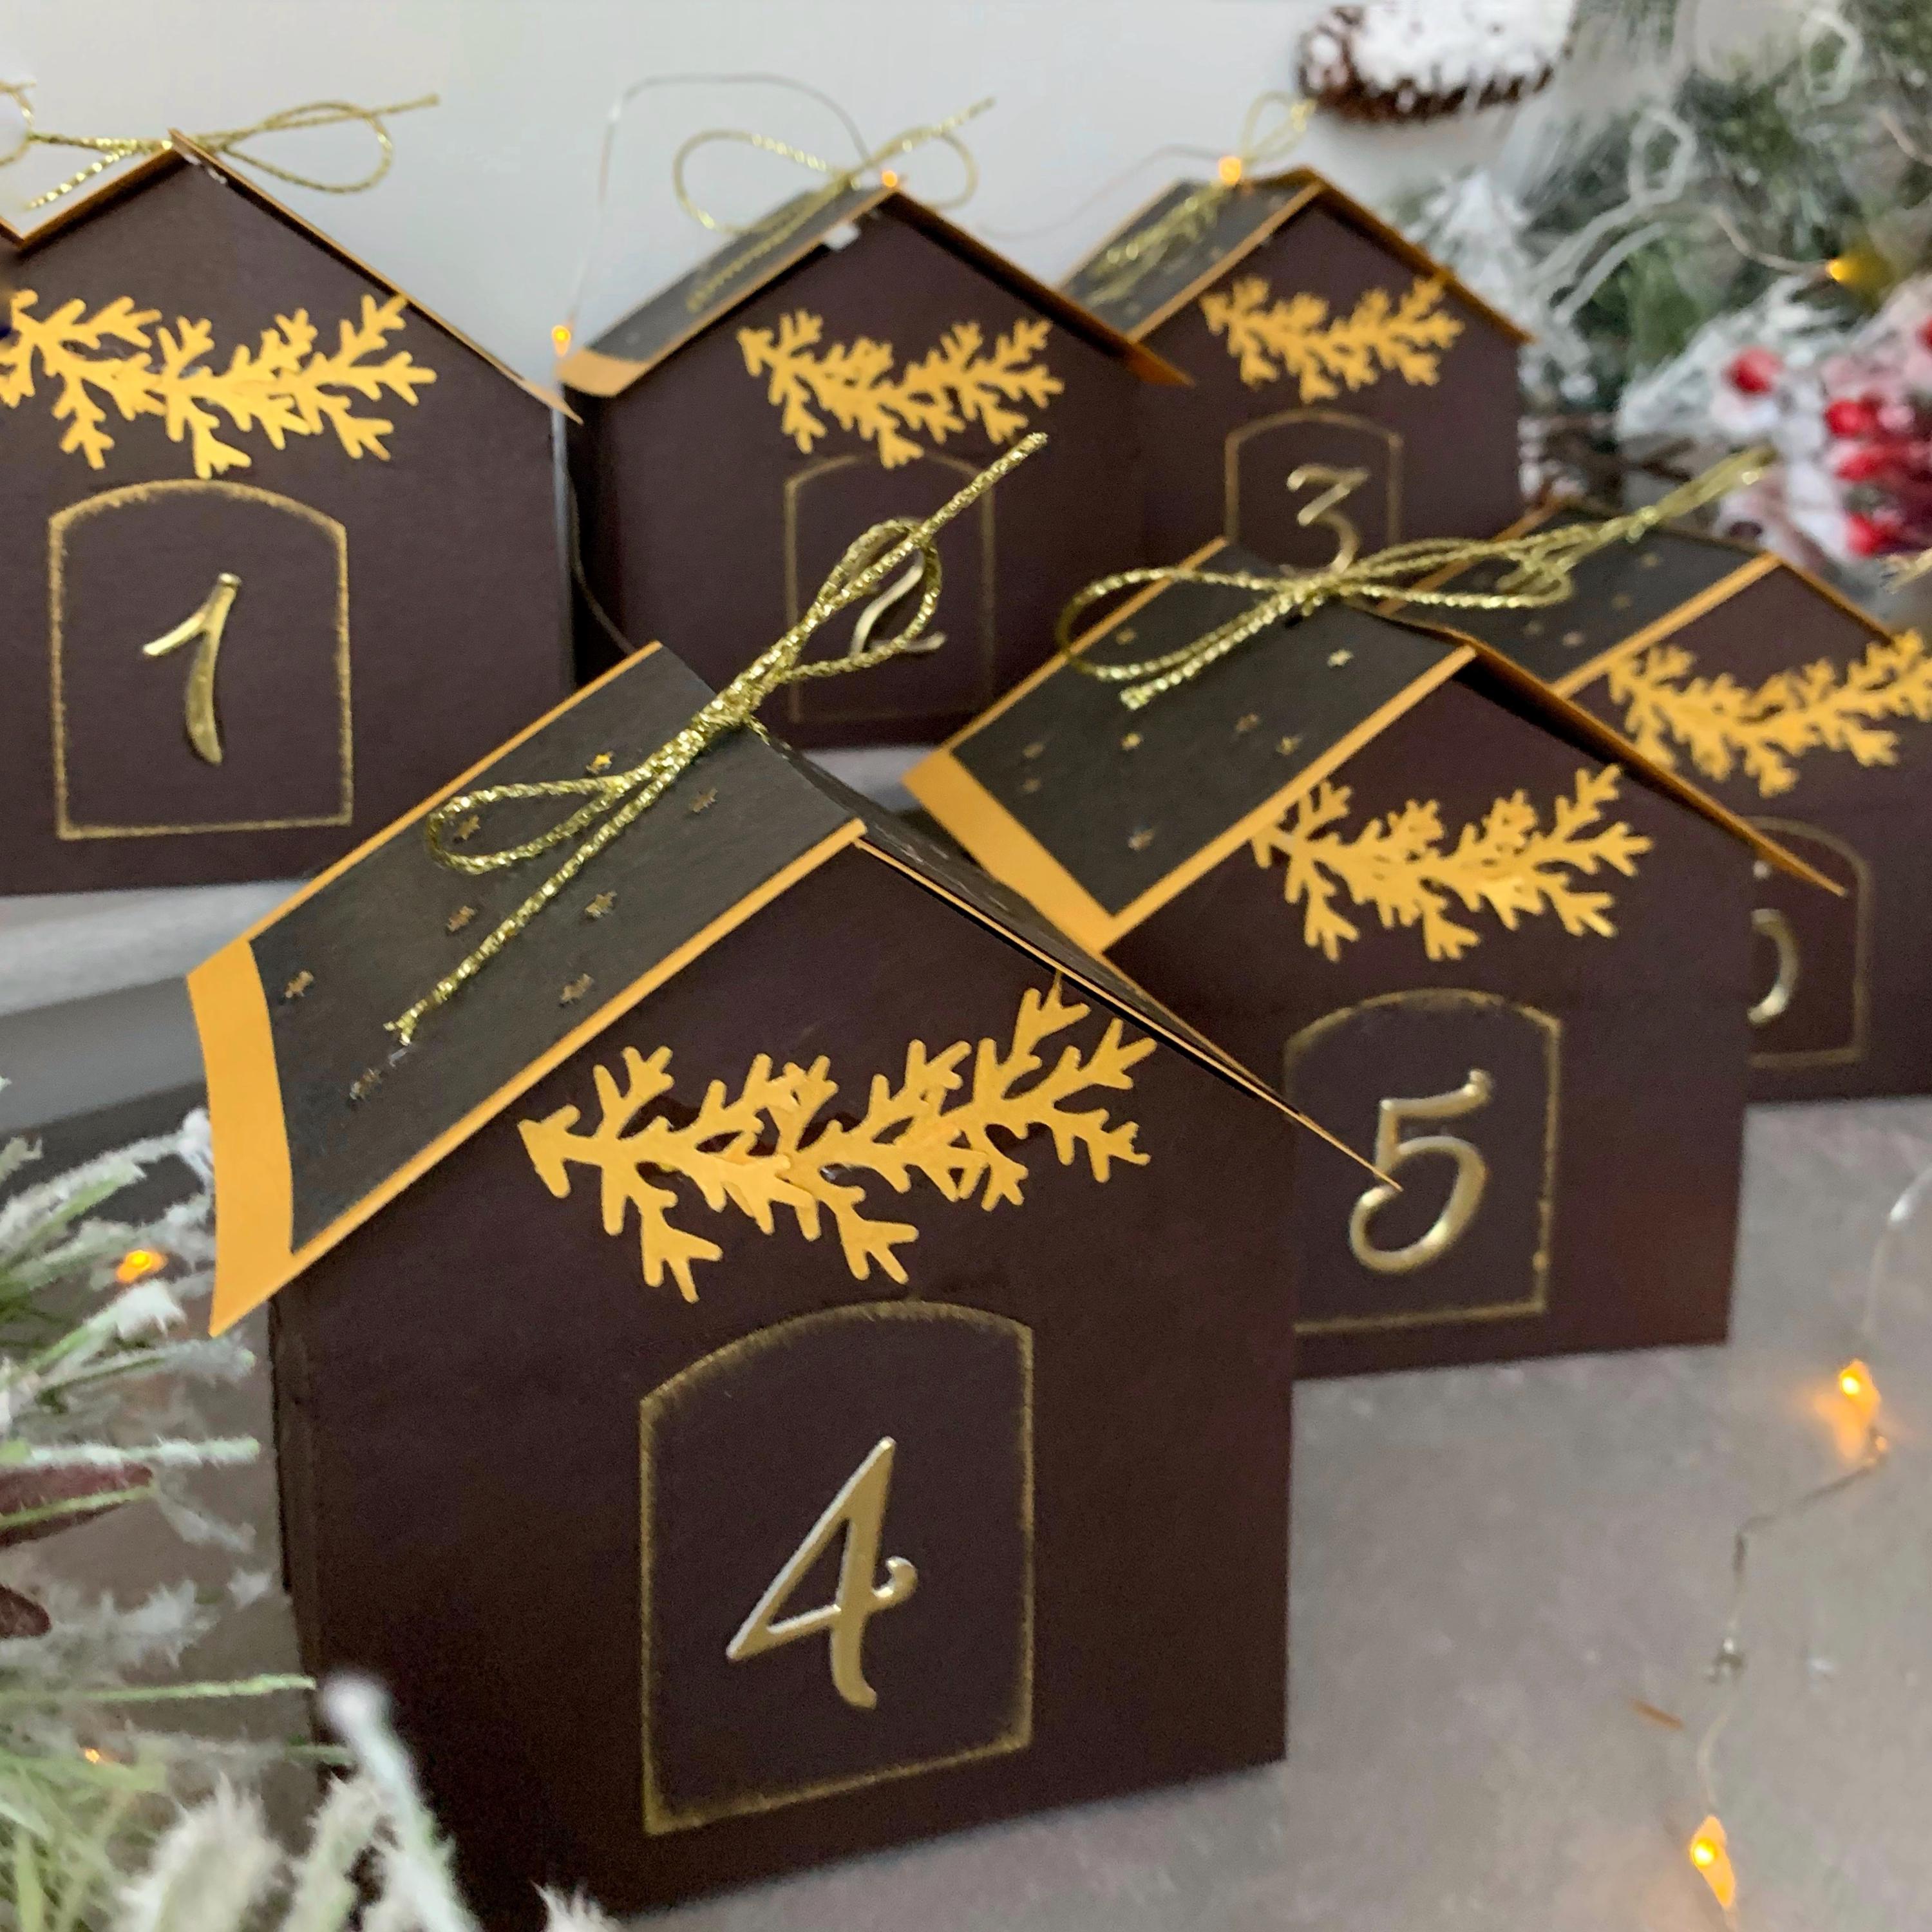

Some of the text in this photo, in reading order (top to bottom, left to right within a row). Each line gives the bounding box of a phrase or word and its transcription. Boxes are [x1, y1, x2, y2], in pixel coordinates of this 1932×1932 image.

[1279, 465, 1368, 587] 3
[142, 573, 242, 766] 1
[1349, 1067, 1493, 1273] 5
[726, 1435, 919, 1710] 4
